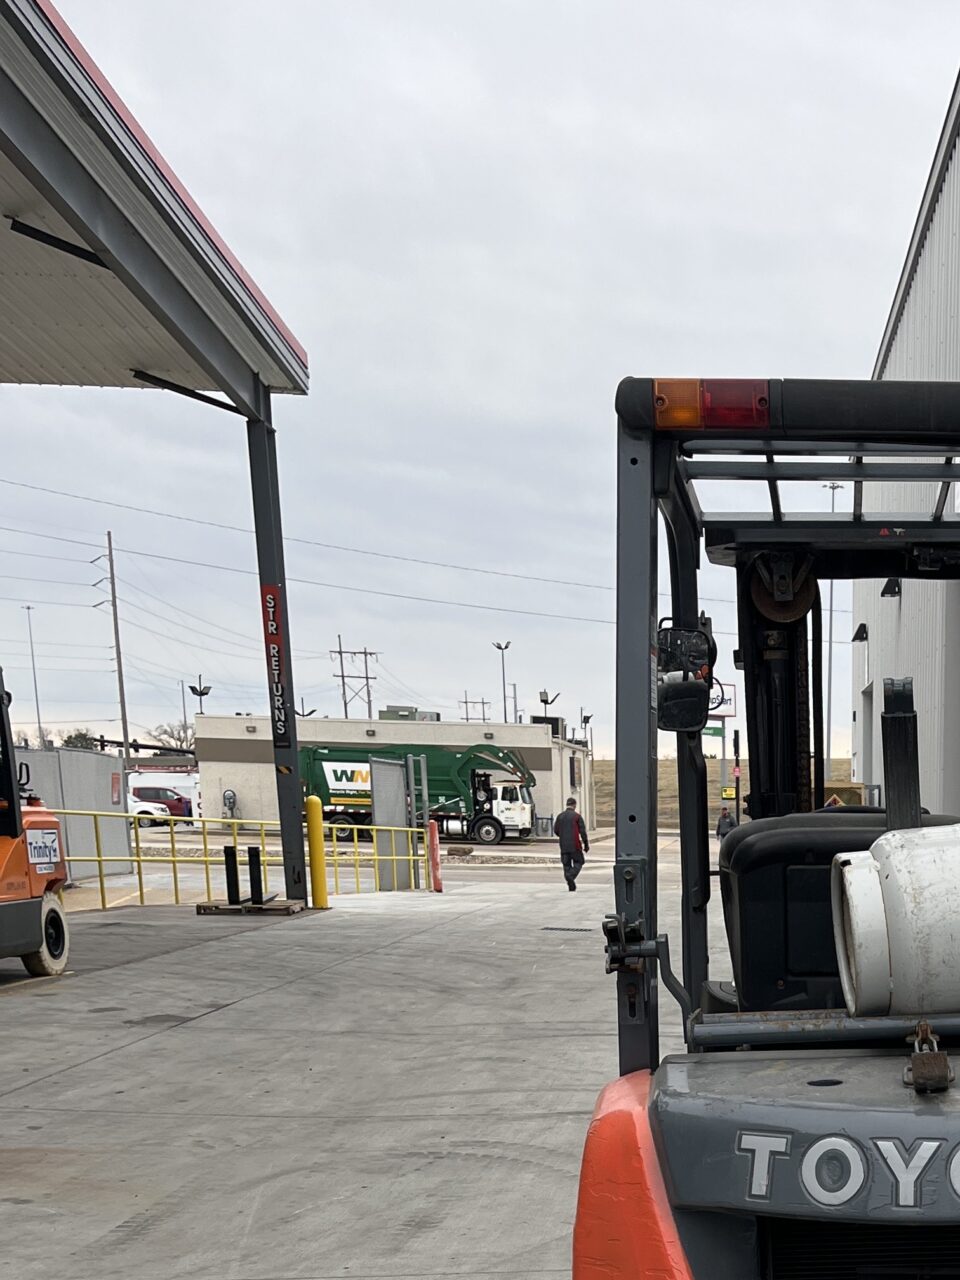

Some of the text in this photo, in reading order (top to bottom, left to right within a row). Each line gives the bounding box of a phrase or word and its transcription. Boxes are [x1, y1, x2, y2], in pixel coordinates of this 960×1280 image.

[266, 594, 286, 735] STR RETURNS
[28, 841, 54, 863] Trinity
